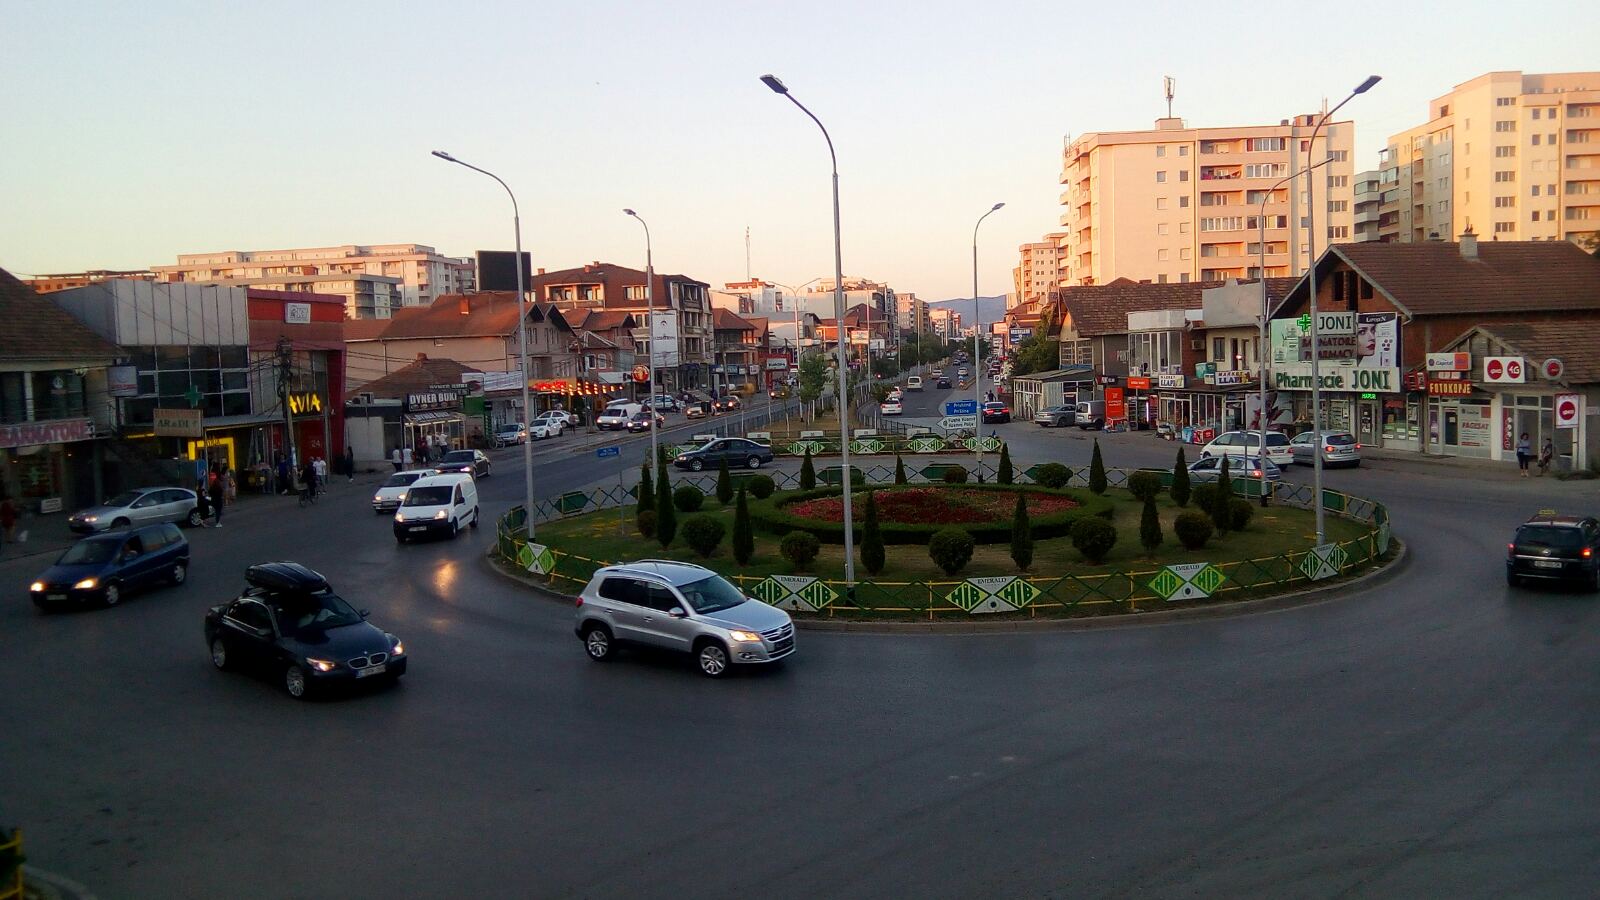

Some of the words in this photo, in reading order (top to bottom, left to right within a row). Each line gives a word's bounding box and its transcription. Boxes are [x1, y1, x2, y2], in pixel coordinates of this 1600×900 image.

[1319, 316, 1352, 330] JONI
[1301, 336, 1357, 348] BANATORE
[1305, 349, 1354, 359] PARMACY
[1508, 366, 1520, 374] 4G
[1352, 370, 1392, 390] JONI
[1429, 383, 1472, 394] FOTOKOPJE
[409, 393, 438, 405] DYNER
[1198, 568, 1218, 592] HIB
[756, 580, 783, 604] HIB
[804, 582, 831, 608] HIB
[951, 584, 980, 609] HIB
[1004, 581, 1033, 607] HIB
